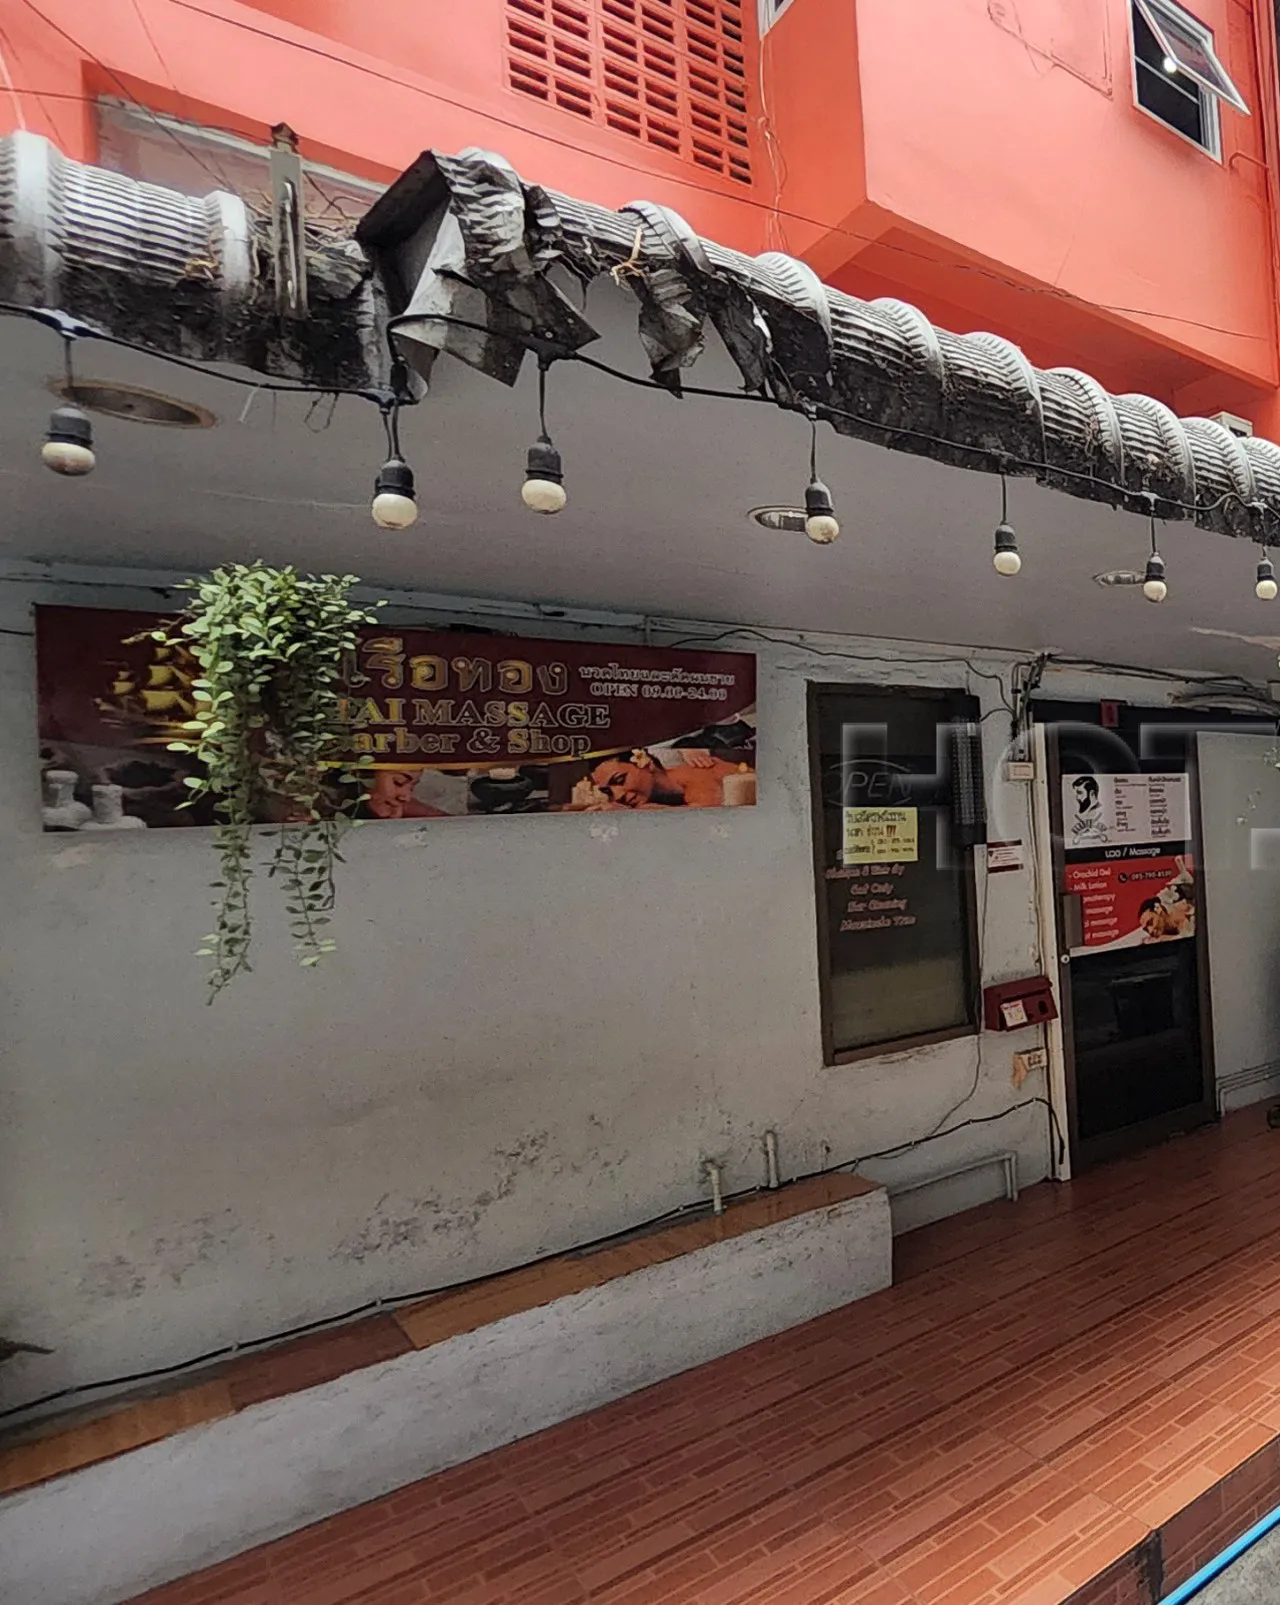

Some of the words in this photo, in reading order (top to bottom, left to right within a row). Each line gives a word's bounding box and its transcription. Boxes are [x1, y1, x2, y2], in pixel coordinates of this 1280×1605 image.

[589, 682, 638, 698] OPEN
[412, 698, 610, 729] MASSAGE
[344, 727, 460, 753] arber
[466, 729, 500, 754] &
[507, 728, 592, 759] Shop
[1129, 847, 1161, 859] Massage
